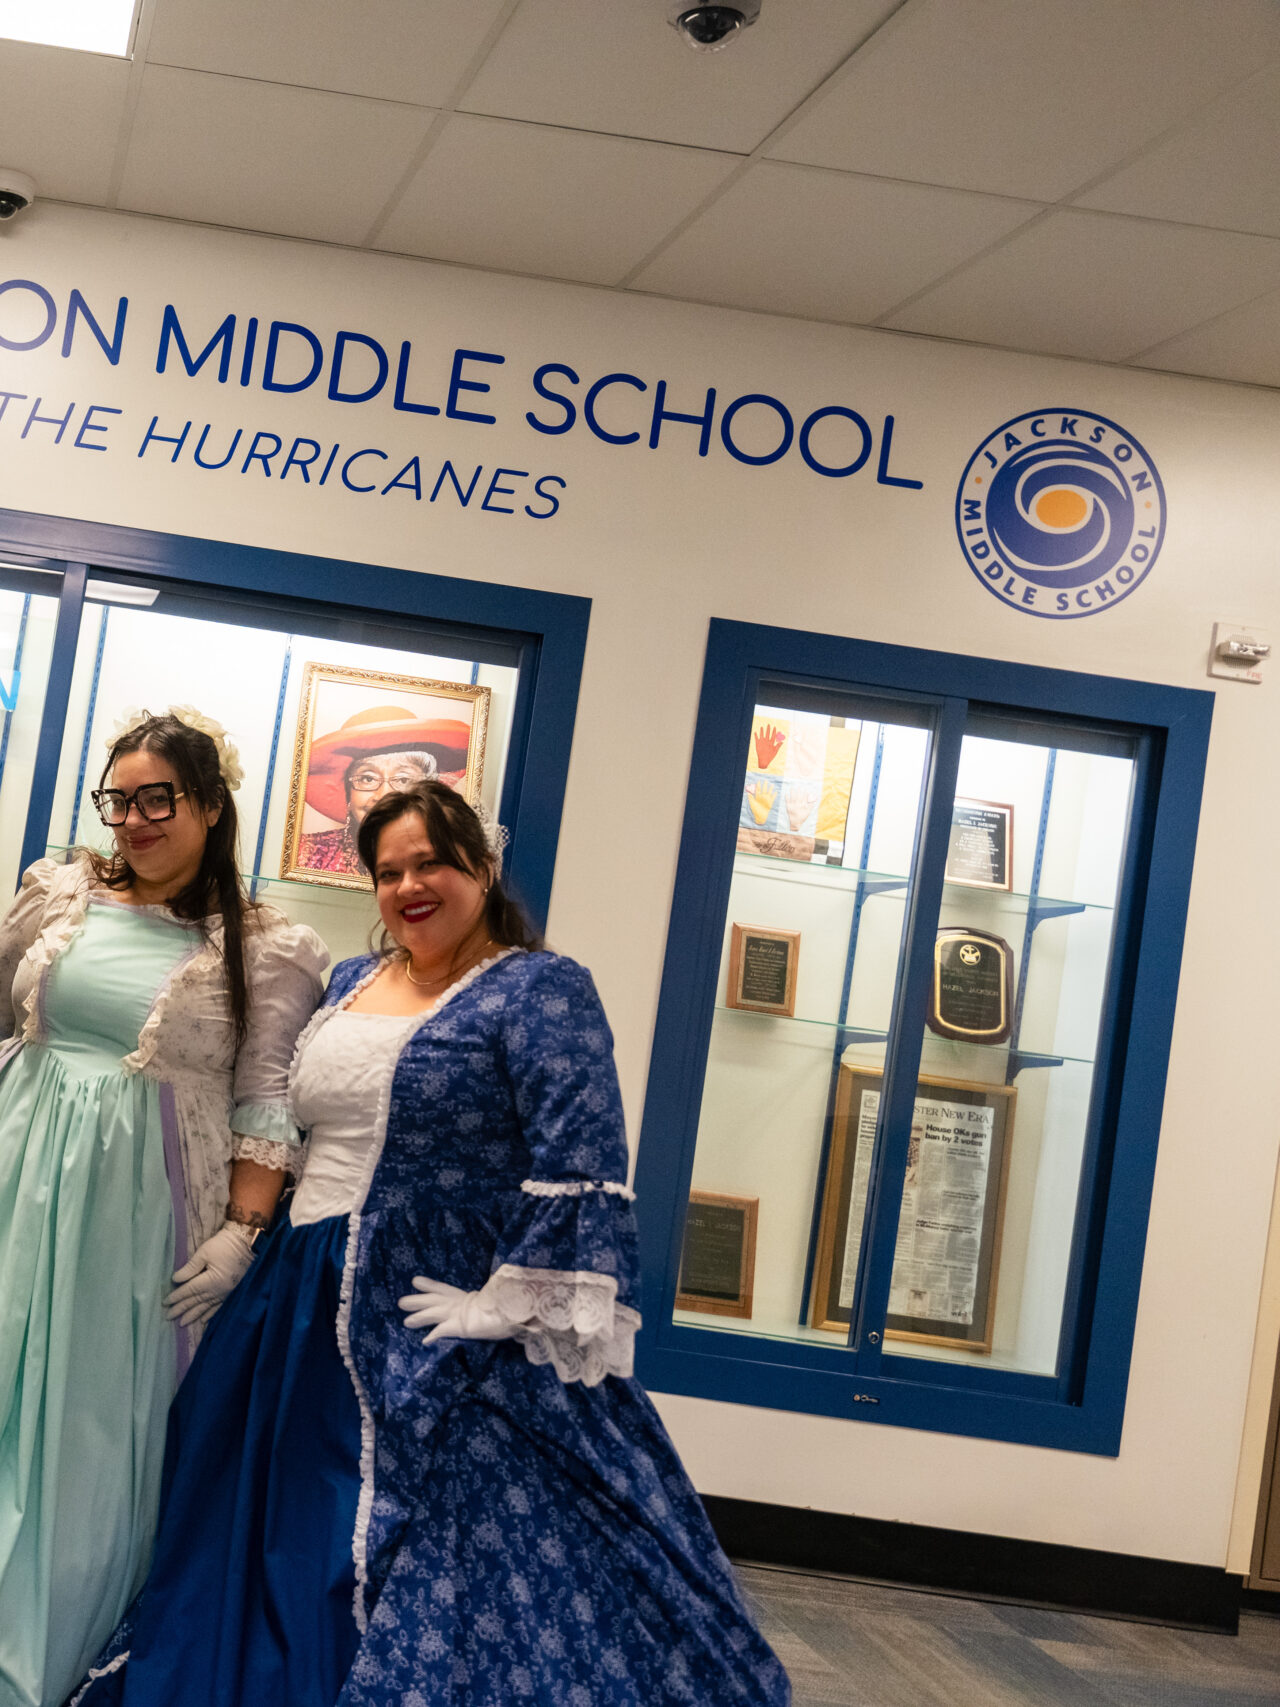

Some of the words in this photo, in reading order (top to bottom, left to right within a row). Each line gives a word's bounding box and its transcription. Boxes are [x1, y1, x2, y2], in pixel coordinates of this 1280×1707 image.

[155, 304, 506, 425] MIDDLE
[525, 363, 924, 490] SCHOOL
[137, 415, 567, 520] HURRICANES
[983, 417, 1152, 492] JACKSON
[963, 498, 1038, 606] MIDDLE
[1056, 525, 1157, 612] SCHOOL
[942, 983, 964, 994] HAZEL
[968, 986, 999, 997] JACKSON
[925, 1132, 940, 1141] ban
[942, 1134, 952, 1144] by
[961, 1139, 983, 1147] votes
[926, 1123, 952, 1134] House
[953, 1127, 970, 1137] OKs
